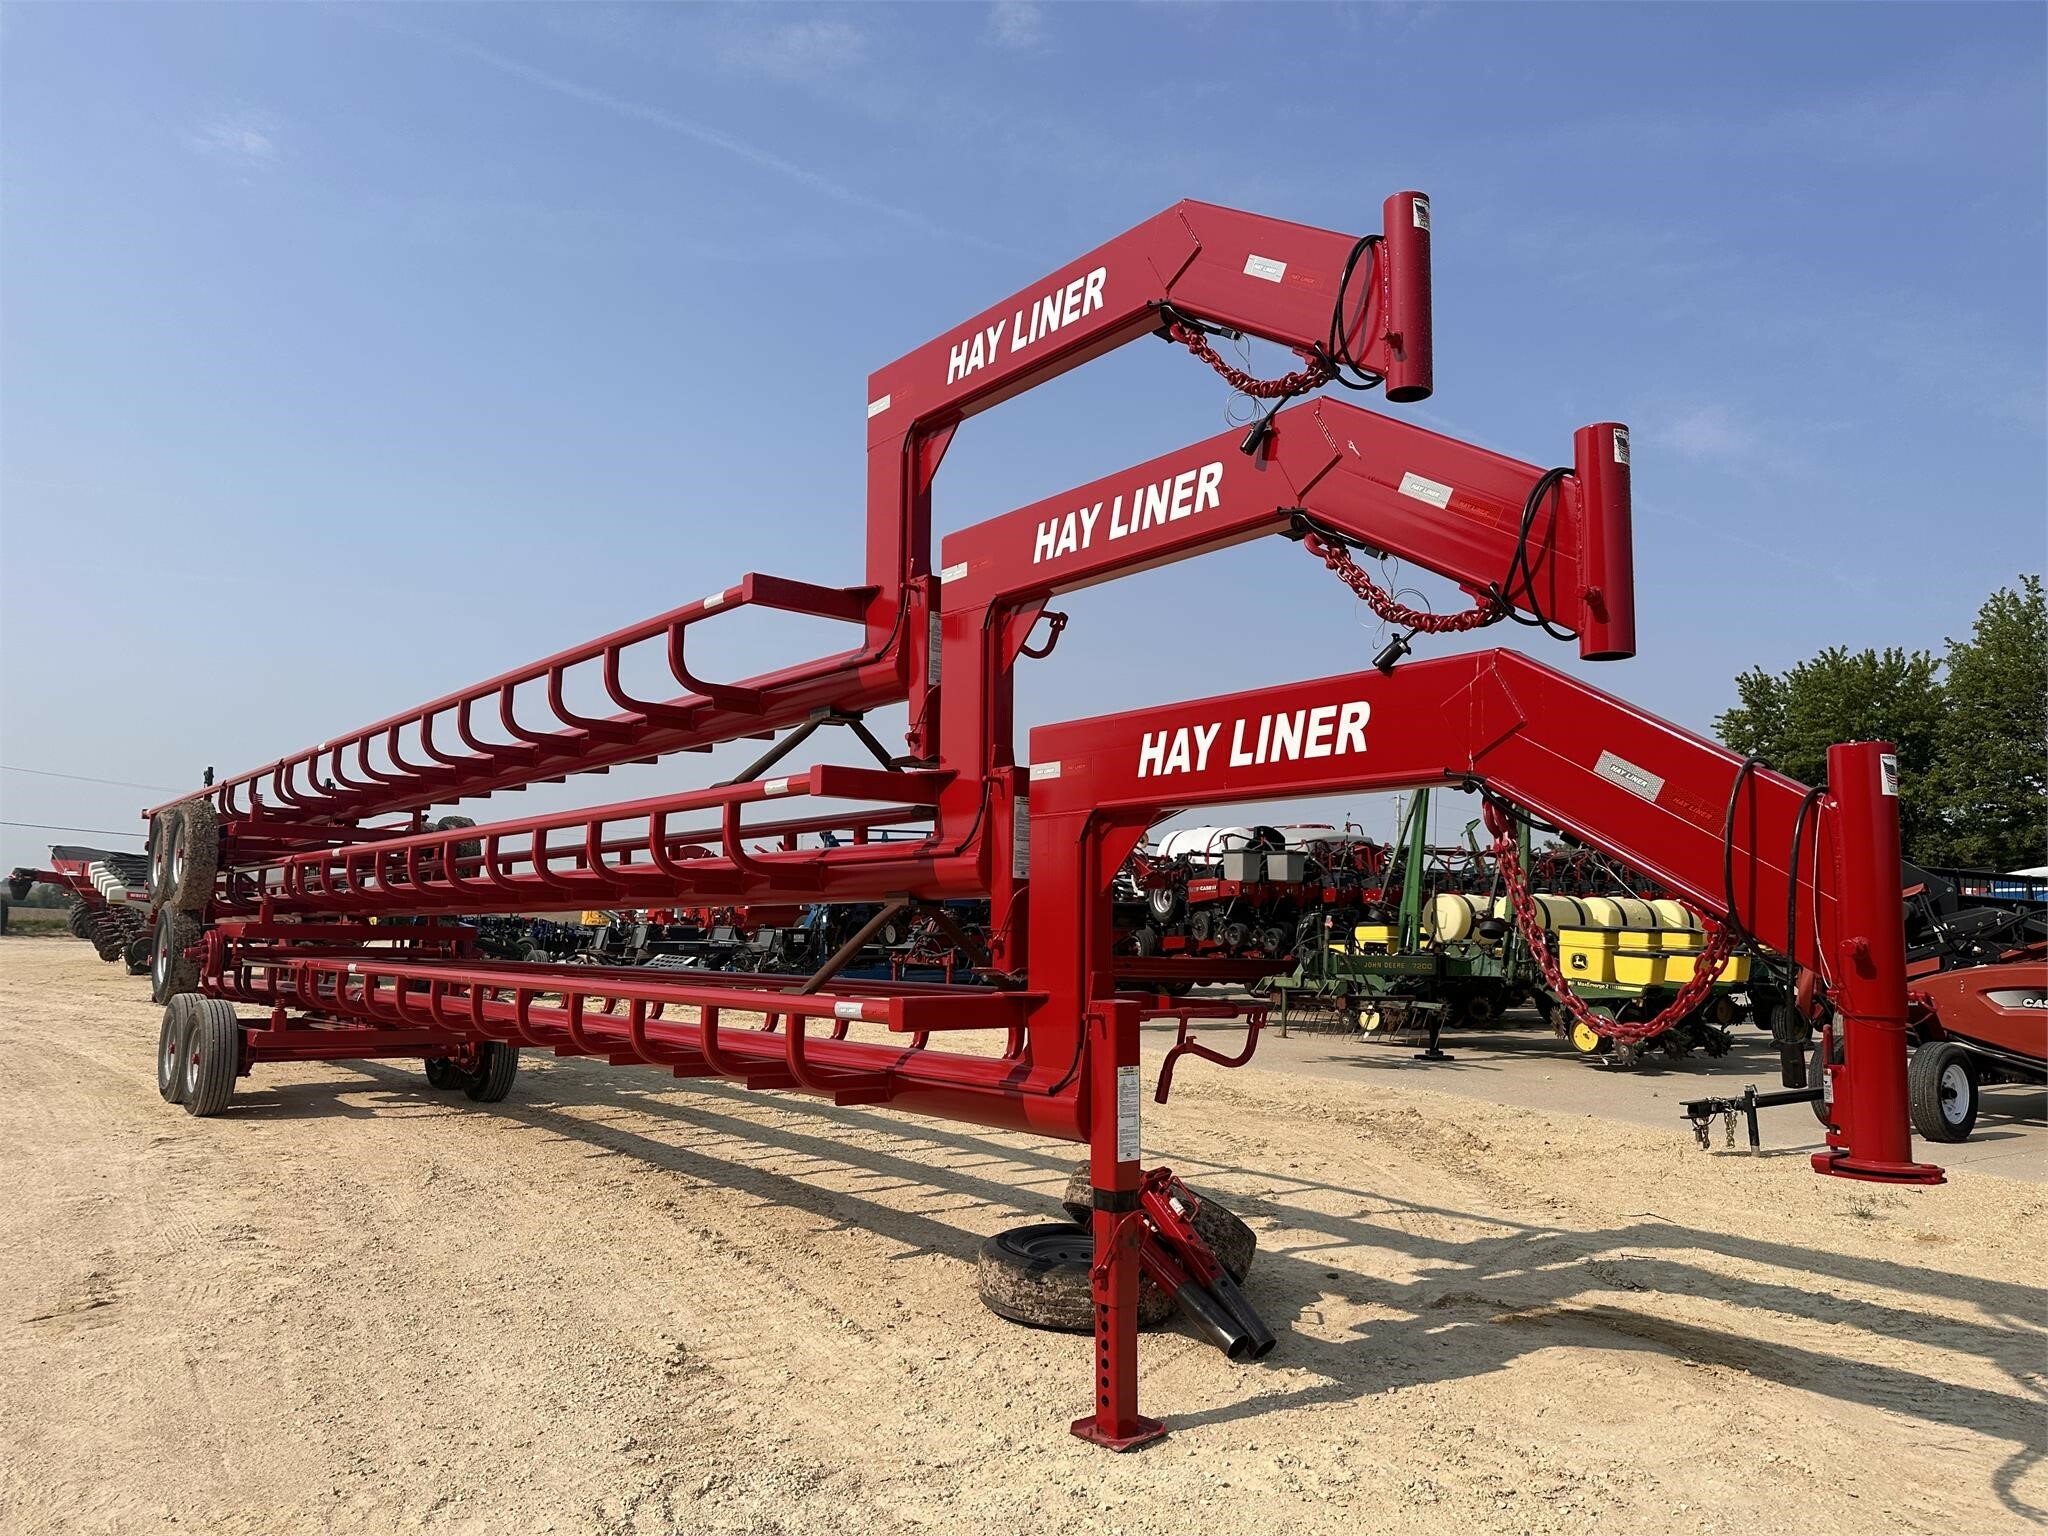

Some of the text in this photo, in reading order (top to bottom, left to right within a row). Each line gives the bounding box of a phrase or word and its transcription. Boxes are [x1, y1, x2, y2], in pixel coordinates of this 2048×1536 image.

[947, 266, 1107, 385] HAY LINER
[1033, 461, 1223, 564] HAY LINER
[1137, 700, 1371, 778] HAY LINER
[1610, 765, 1648, 787] HAY LINER
[1672, 797, 1713, 819] HAY LINER
[1364, 961, 1433, 970] JOHN DEERE 7200
